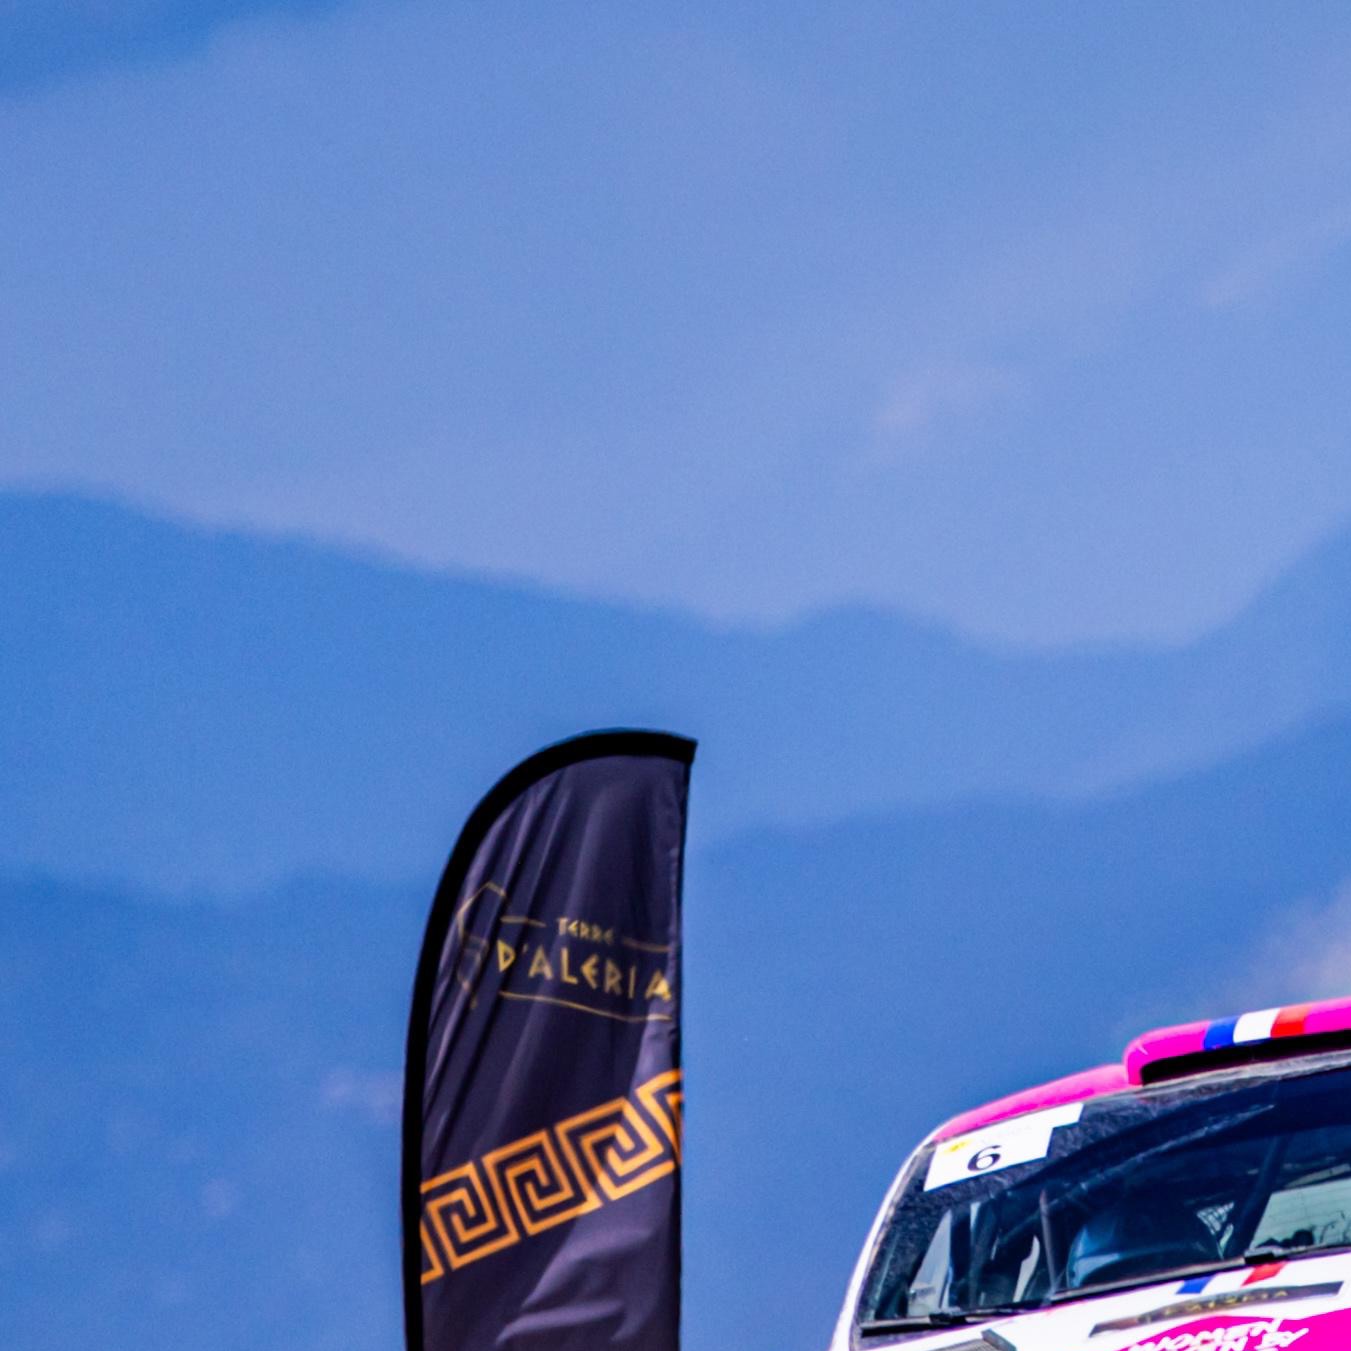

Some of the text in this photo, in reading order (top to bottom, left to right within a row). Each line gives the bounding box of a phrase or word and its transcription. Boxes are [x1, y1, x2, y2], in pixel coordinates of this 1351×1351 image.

[556, 917, 615, 944] TERRE
[496, 939, 672, 1002] D'ALERIA
[967, 1144, 1002, 1172] 6
